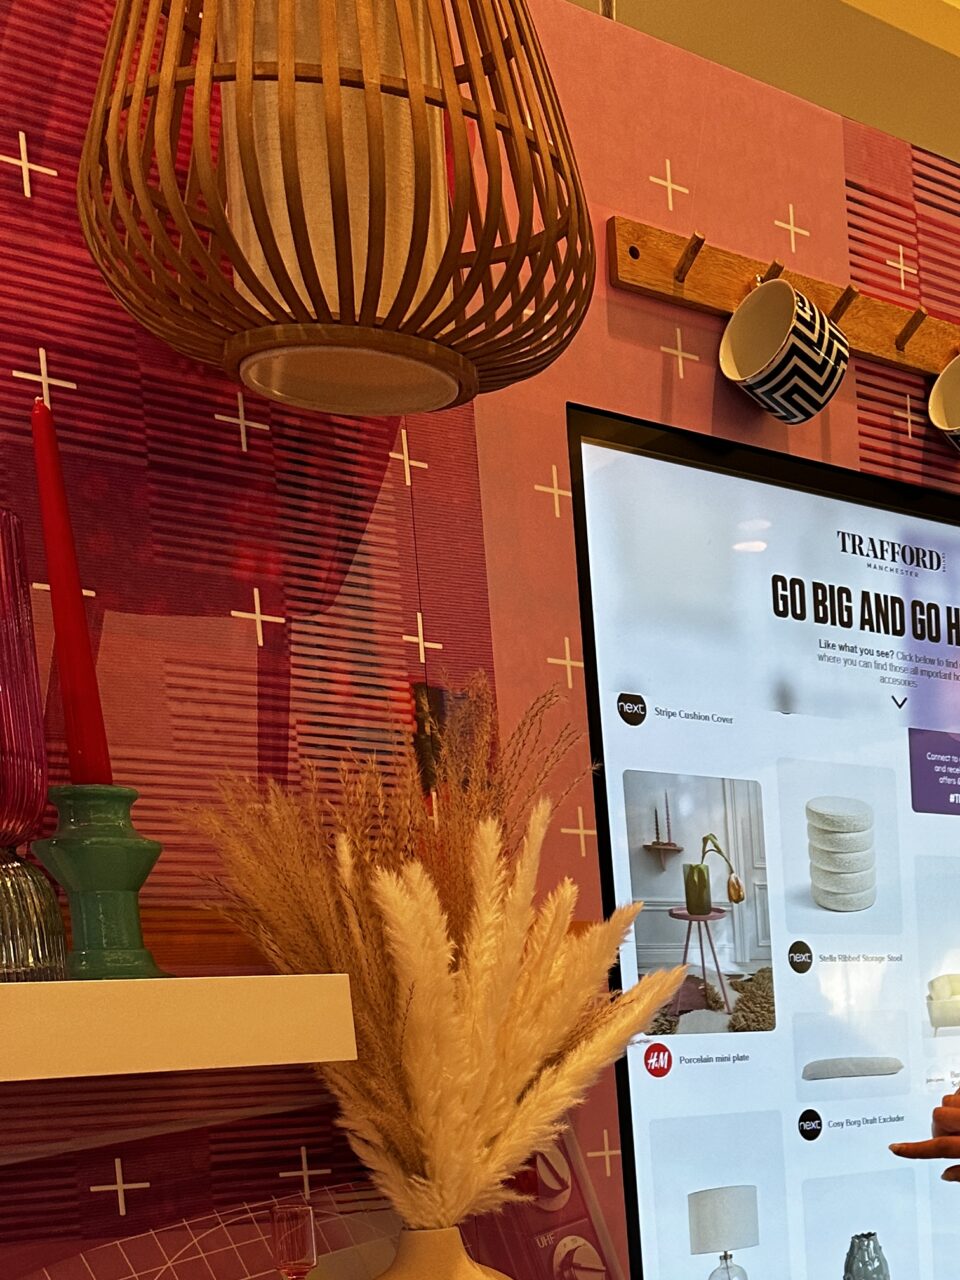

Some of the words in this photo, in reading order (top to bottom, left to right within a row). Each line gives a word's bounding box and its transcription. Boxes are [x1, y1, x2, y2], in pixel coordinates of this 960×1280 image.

[837, 531, 942, 571] TRAFFORD
[866, 562, 919, 577] MANCHESTER
[771, 574, 807, 621] GO
[812, 581, 853, 629] BIG
[859, 590, 905, 637] AND
[910, 599, 941, 644] GO
[818, 639, 836, 650] Like
[838, 642, 857, 654] what
[859, 647, 874, 657] you
[876, 649, 894, 658] see?
[896, 652, 913, 662] Click
[915, 654, 935, 665] below
[936, 658, 944, 667] to
[945, 659, 958, 669] find
[817, 653, 841, 664] where
[843, 657, 857, 668] you
[858, 660, 873, 668] can
[874, 661, 887, 671] find
[889, 663, 908, 673] those
[911, 667, 919, 675] all
[920, 669, 952, 680] important
[618, 702, 645, 714] next
[655, 707, 677, 719] Stripe
[678, 709, 710, 722] Cushion
[711, 713, 733, 724] Cover
[926, 752, 951, 762] Connect
[951, 755, 958, 763] to
[934, 765, 946, 773] and
[789, 953, 811, 963] next
[647, 1051, 669, 1070] H&M
[679, 1055, 714, 1064] Porcelain
[715, 1054, 731, 1063] mini
[732, 1053, 750, 1063] plate
[799, 1120, 821, 1130] next
[828, 1120, 844, 1129] Cosy
